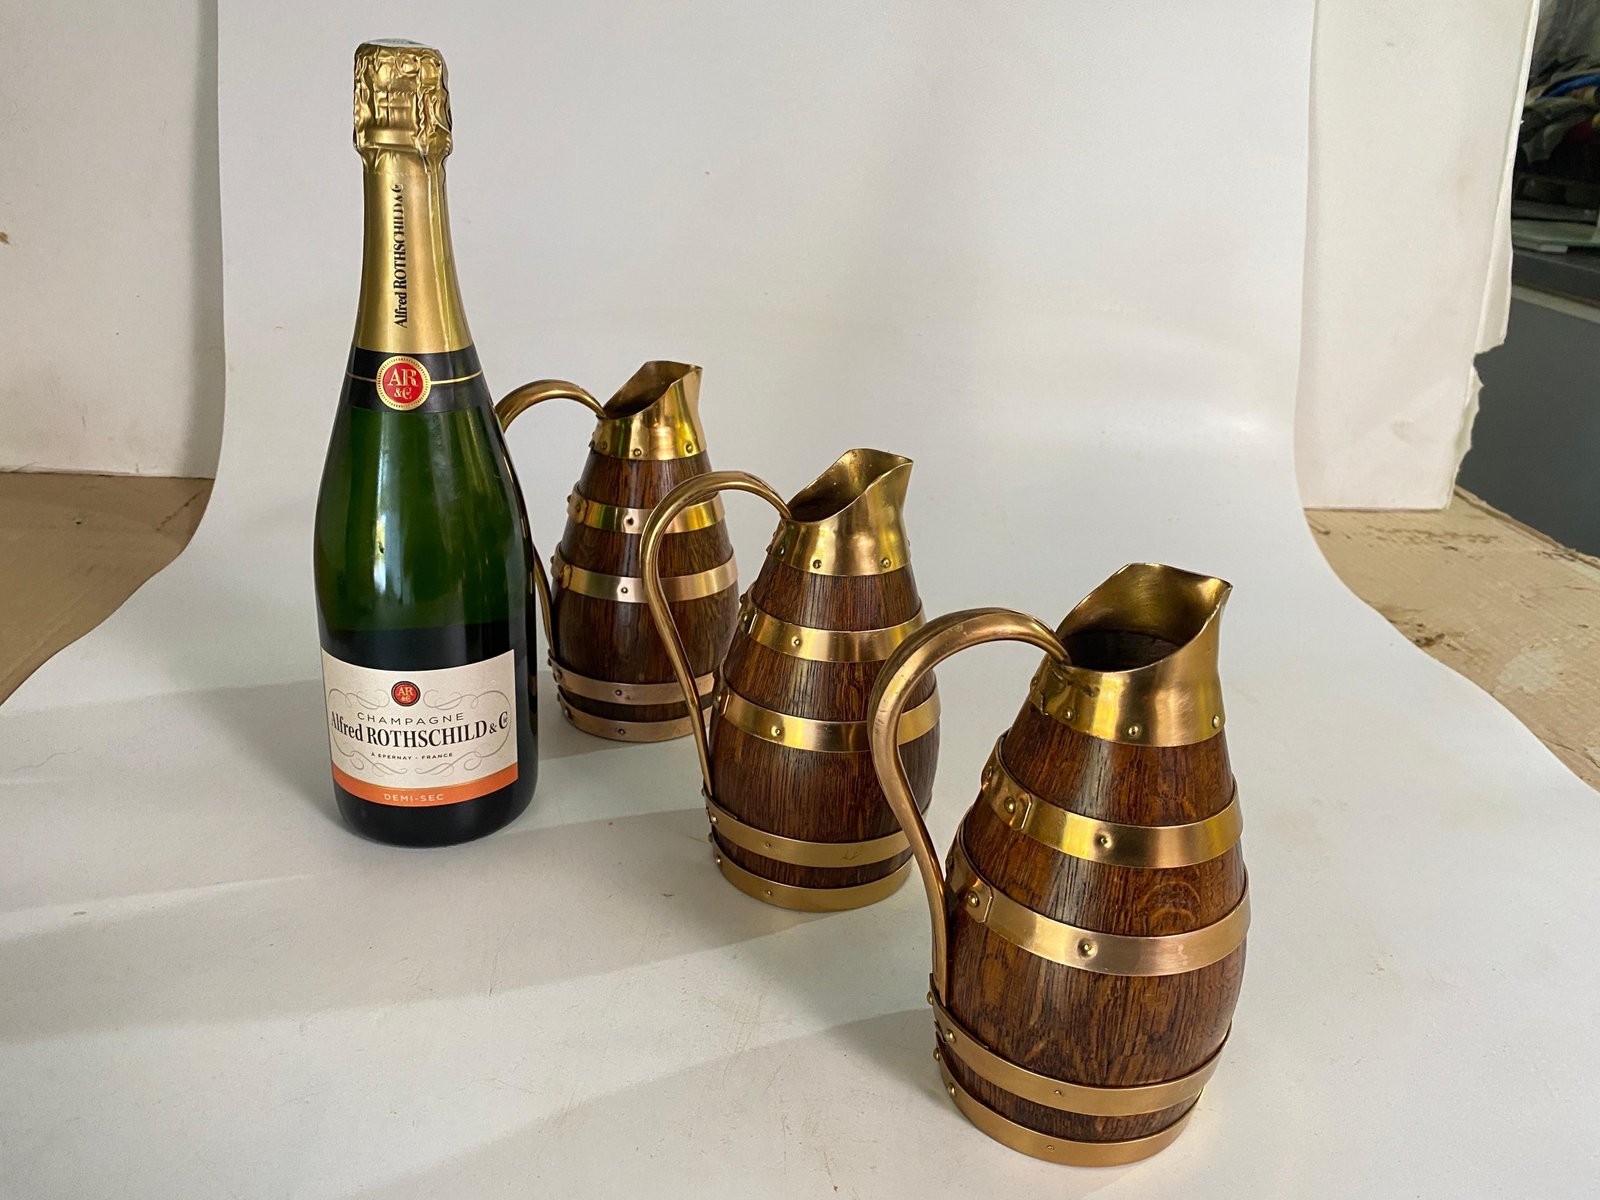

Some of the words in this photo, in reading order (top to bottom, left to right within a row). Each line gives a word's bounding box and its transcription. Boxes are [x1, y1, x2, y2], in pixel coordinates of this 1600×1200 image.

[393, 203, 407, 290] ROTHSCHILD
[394, 293, 408, 329] Alfred
[387, 368, 418, 386] AR
[397, 686, 414, 696] AR
[357, 712, 465, 725] CHAMPAGNE
[329, 711, 364, 742] Alfred
[366, 720, 488, 748] ROTHSCHILD
[421, 752, 454, 760] FRANCE
[383, 793, 445, 802] DEMI-SEC
